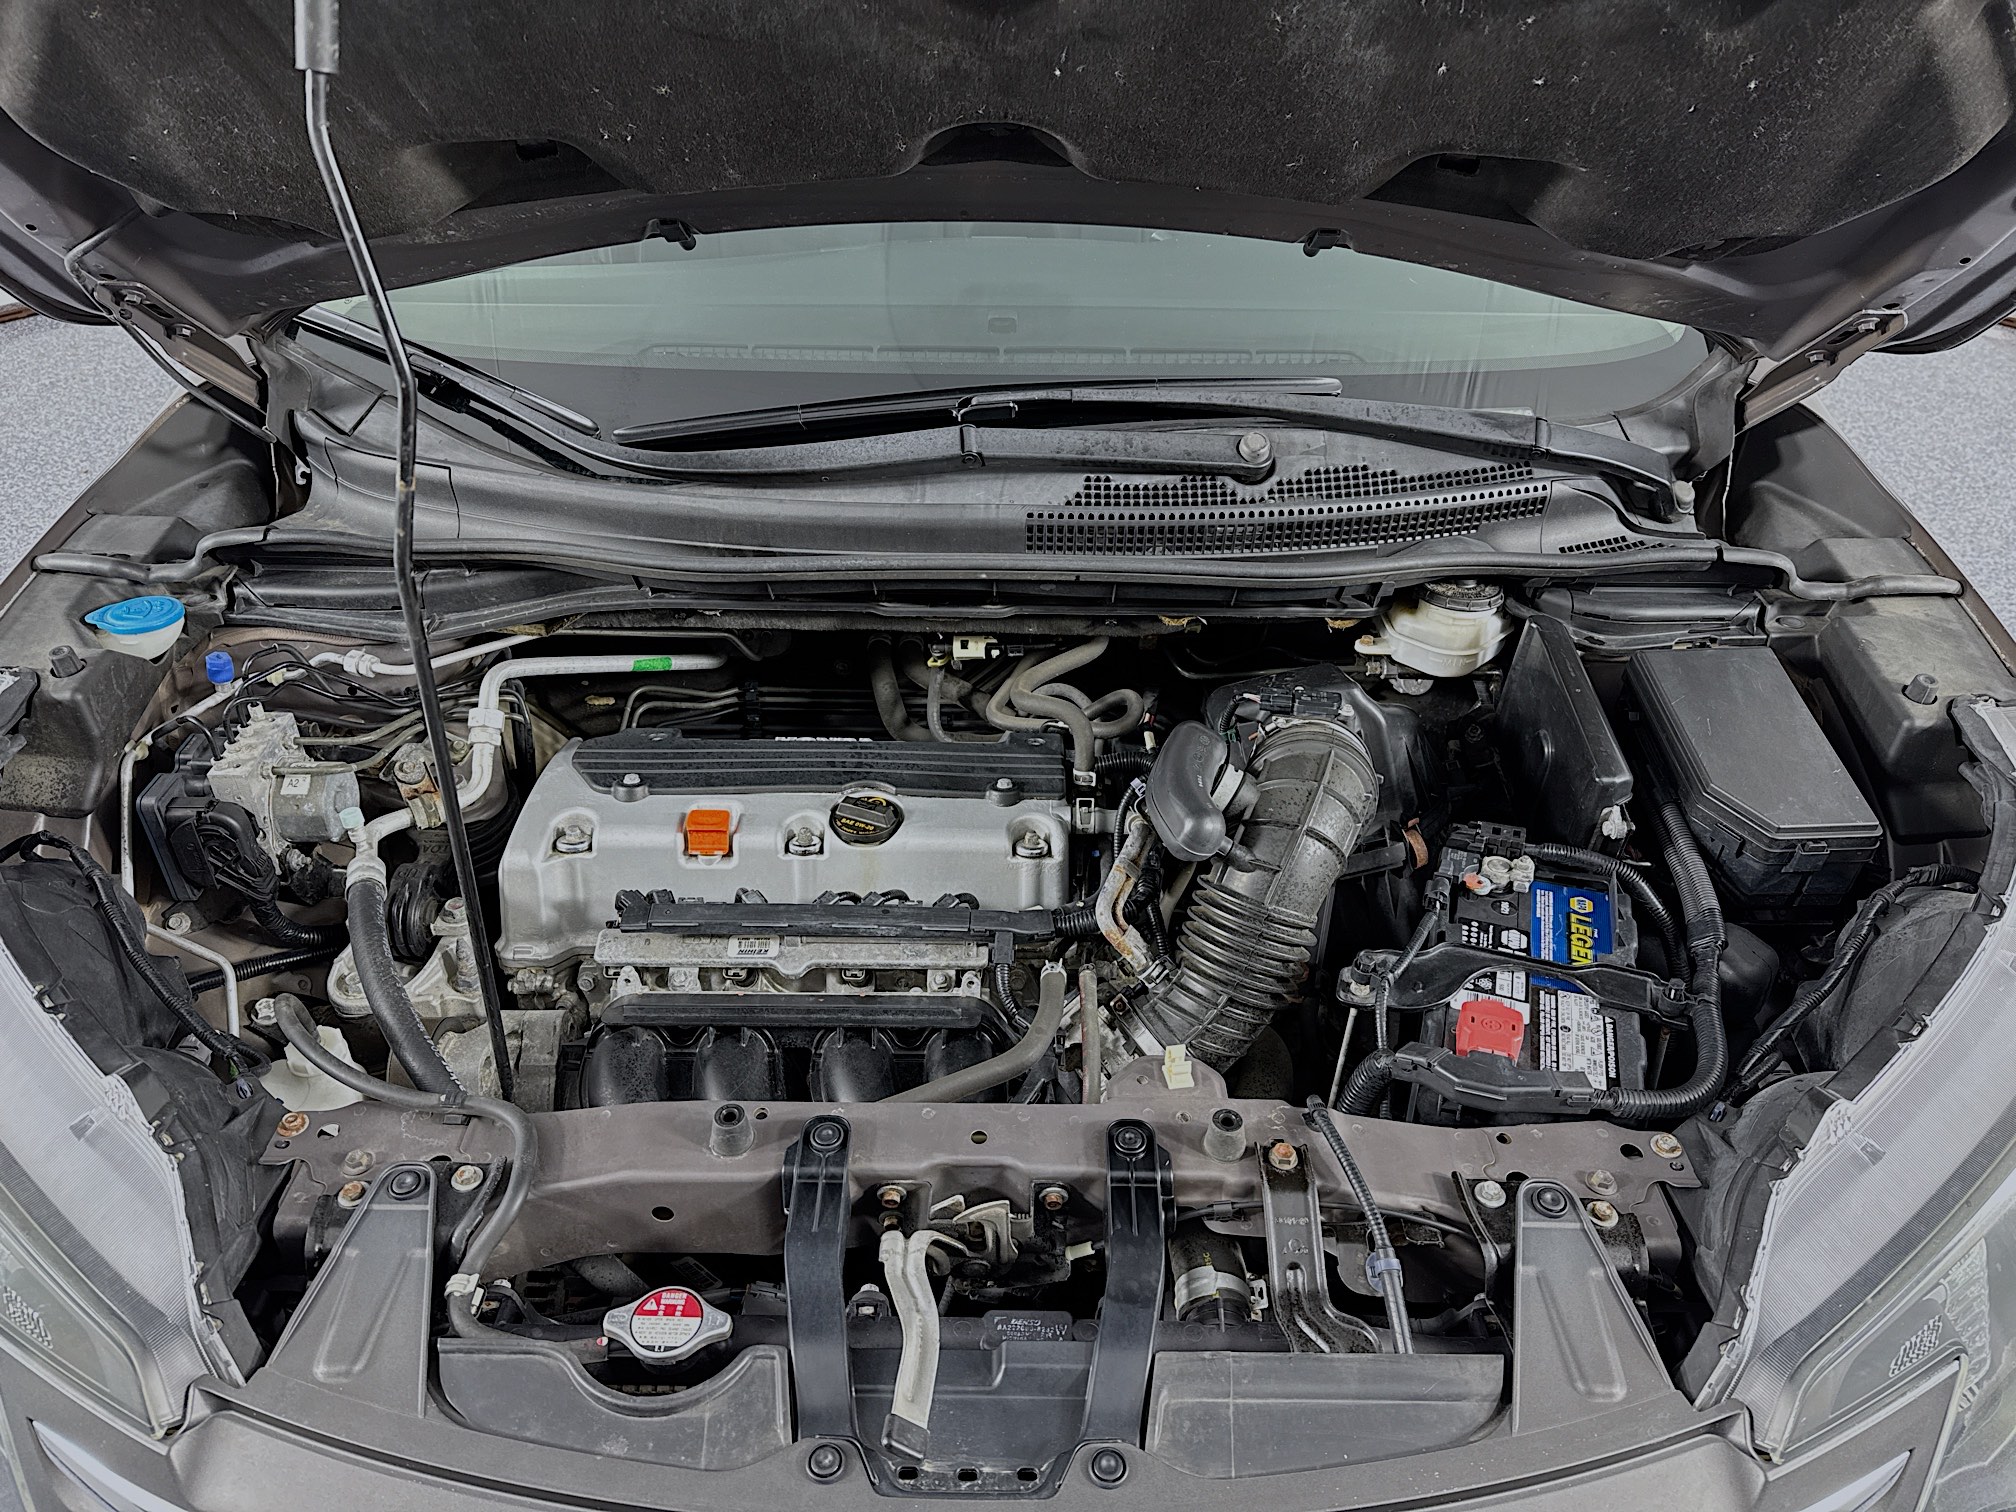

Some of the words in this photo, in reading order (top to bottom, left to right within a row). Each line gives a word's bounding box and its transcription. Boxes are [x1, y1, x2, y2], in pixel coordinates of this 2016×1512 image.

[287, 778, 299, 787] A2
[1569, 912, 1594, 966] LEGEN
[1010, 1318, 1042, 1326] DENSO
